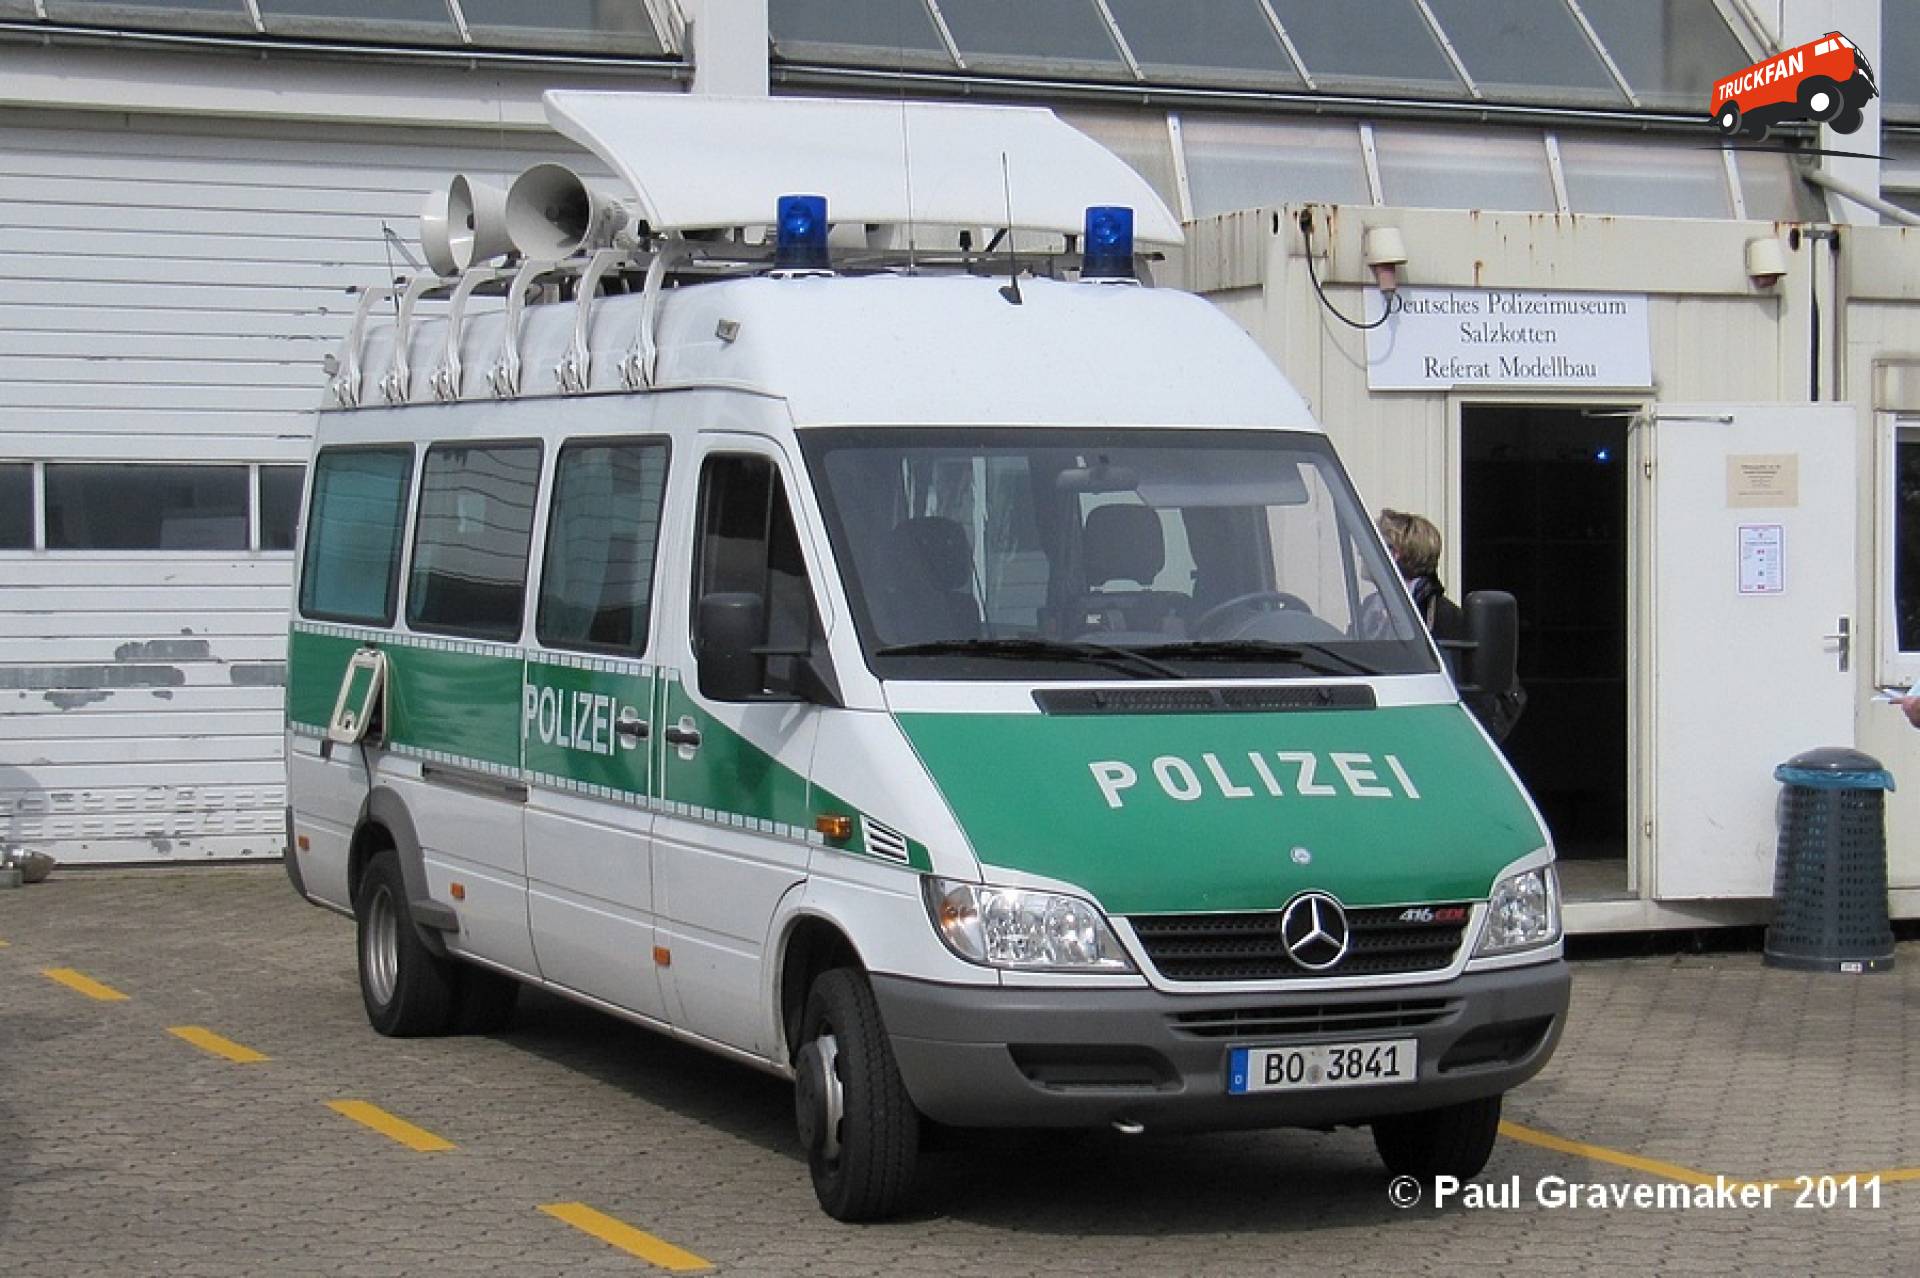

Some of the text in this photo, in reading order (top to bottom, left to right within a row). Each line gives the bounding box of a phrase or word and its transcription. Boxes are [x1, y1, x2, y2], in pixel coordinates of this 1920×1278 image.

[1488, 293, 1627, 315] Polizeimuseum
[1460, 322, 1557, 344] Salzkotten
[1424, 356, 1598, 378] Referat Modellbau
[524, 684, 616, 756] POLIZEI
[1088, 752, 1420, 808] POLIZEI
[1264, 1045, 1400, 1084] BO 3841
